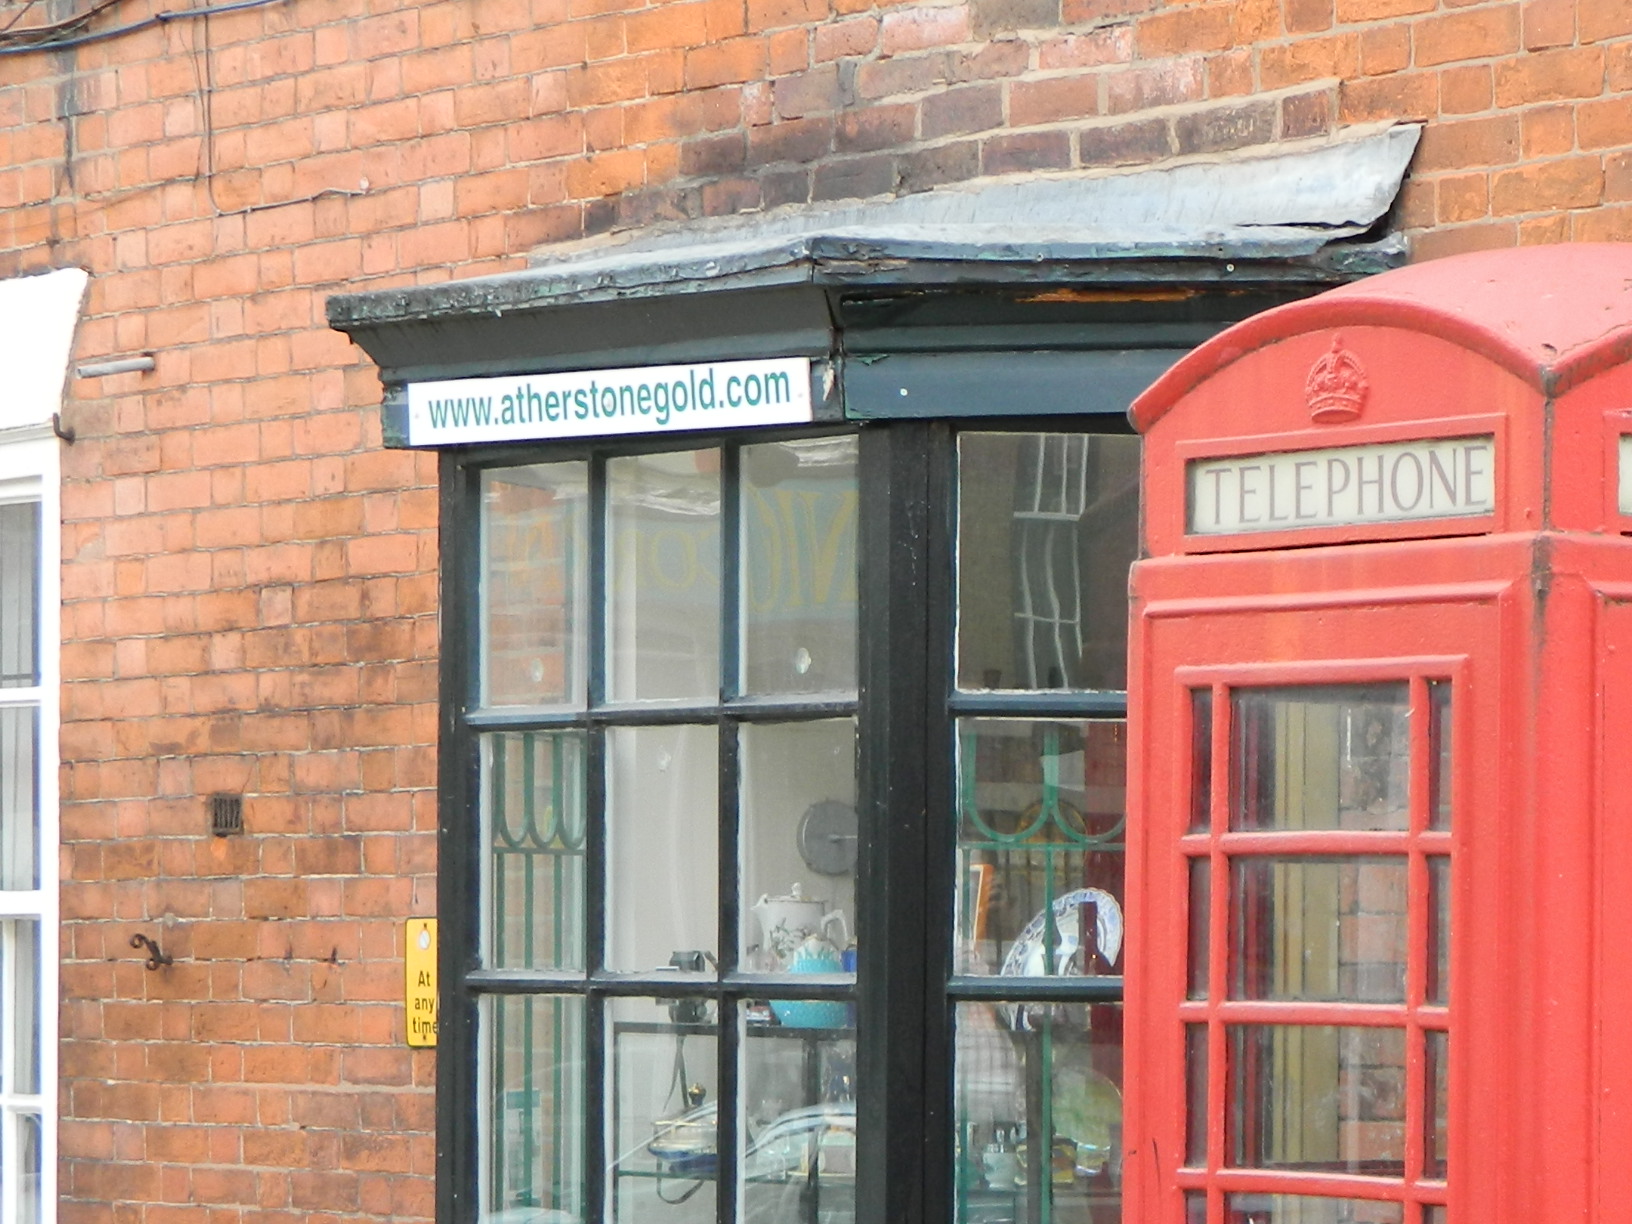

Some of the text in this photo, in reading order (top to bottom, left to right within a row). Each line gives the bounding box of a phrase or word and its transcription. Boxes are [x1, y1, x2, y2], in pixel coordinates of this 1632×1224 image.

[428, 367, 791, 429] www.atherstonegold.com
[1205, 445, 1488, 526] TELEPHONE
[417, 970, 431, 988] At
[414, 997, 436, 1014] any
[412, 1017, 439, 1034] time
